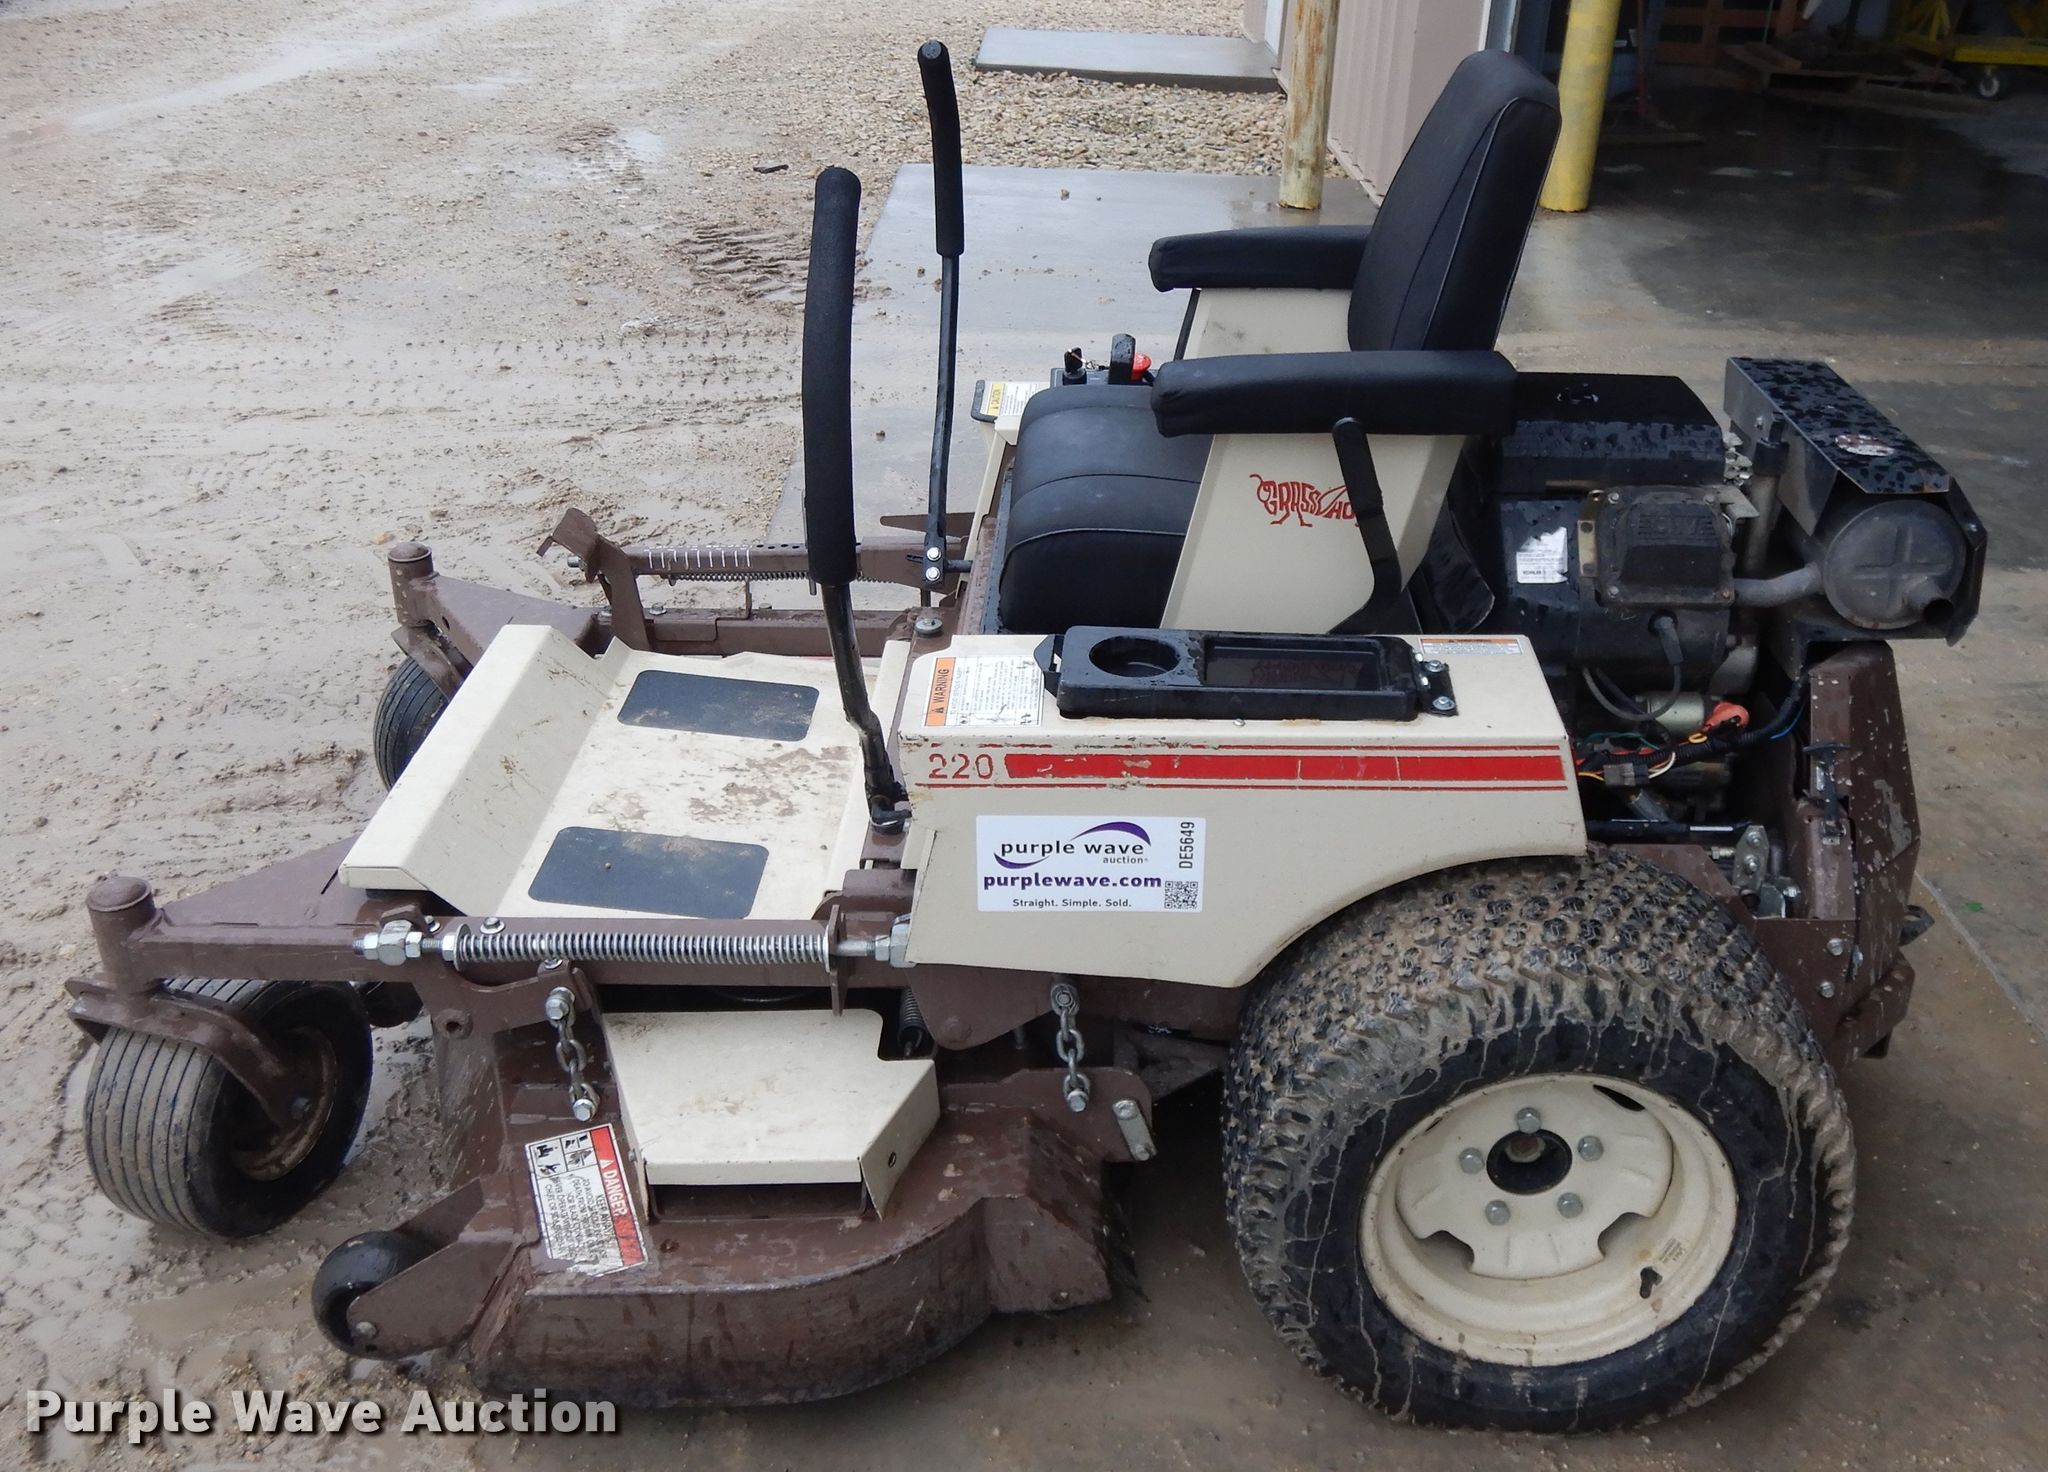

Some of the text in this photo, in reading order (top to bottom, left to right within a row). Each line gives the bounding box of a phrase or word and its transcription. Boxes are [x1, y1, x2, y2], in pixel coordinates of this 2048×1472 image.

[933, 668, 950, 701] WARNING
[928, 753, 994, 780] 220
[1001, 841, 1144, 857] purple wave
[1179, 821, 1195, 869] DE5649
[1103, 855, 1144, 864] auction
[983, 873, 1162, 890] purplewave.com
[1013, 899, 1132, 909] Straight. Simple. Sold.
[602, 1169, 628, 1217] DANGER
